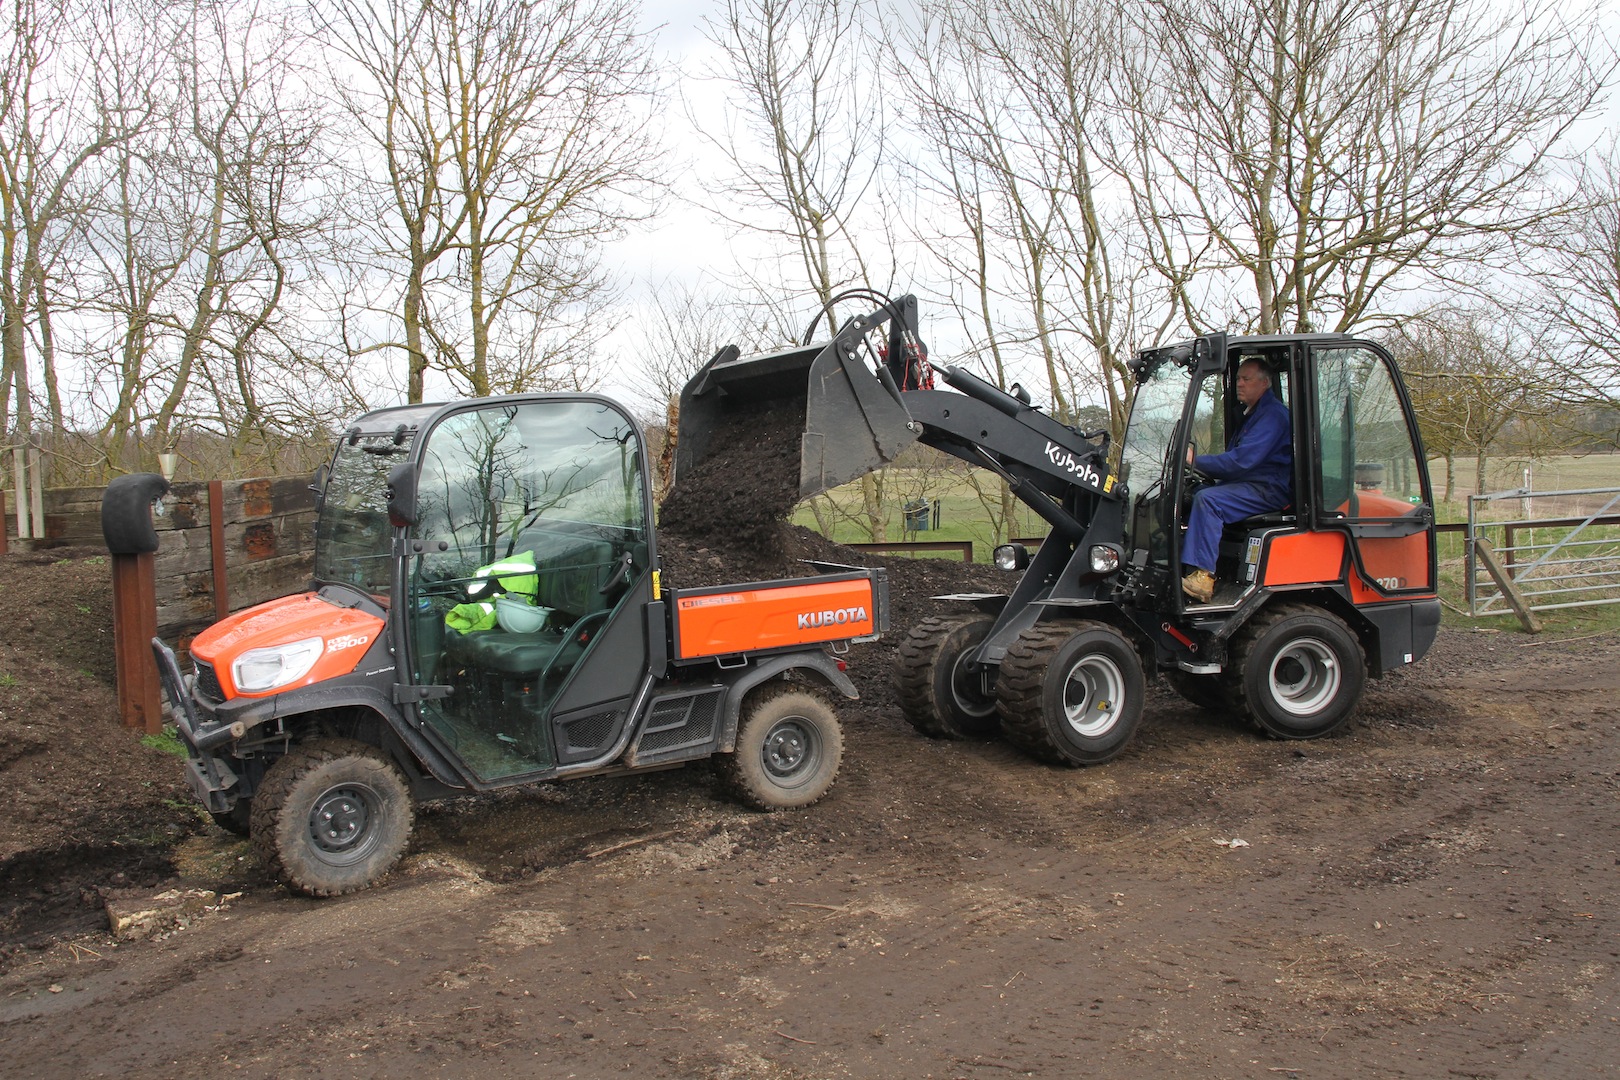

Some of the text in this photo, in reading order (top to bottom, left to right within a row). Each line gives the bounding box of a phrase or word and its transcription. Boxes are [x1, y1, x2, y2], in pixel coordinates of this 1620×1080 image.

[1044, 441, 1100, 488] Kubota
[682, 595, 743, 608] DIESEL
[797, 606, 868, 629] KUBOTA
[327, 634, 352, 646] RTV
[327, 636, 368, 653] X900
